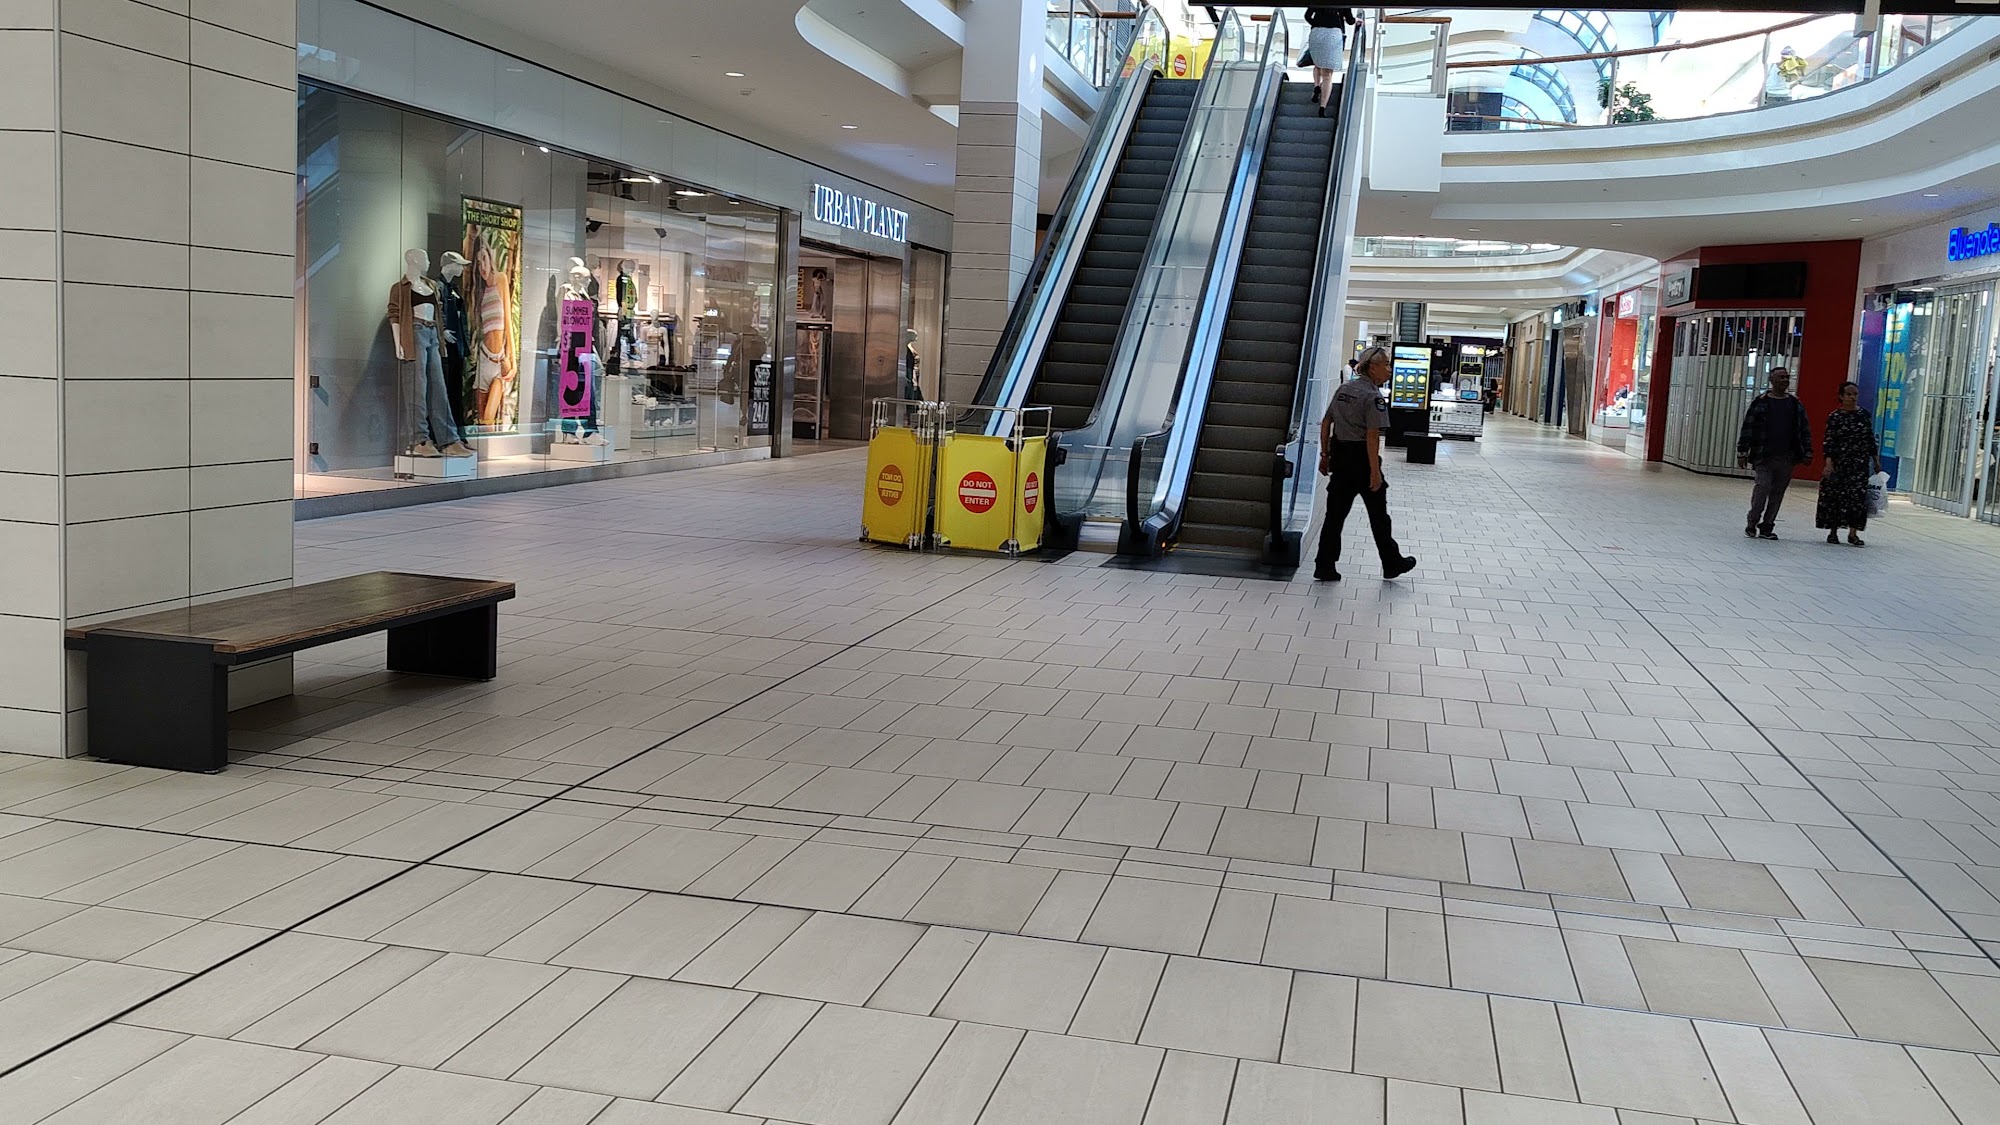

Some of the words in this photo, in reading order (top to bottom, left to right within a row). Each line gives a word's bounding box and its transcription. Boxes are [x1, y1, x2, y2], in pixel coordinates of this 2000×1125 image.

[467, 210, 480, 222] THE
[481, 213, 500, 226] SHORT
[500, 216, 517, 228] SHOP
[814, 183, 862, 231] URBAN
[863, 200, 909, 243] PLANET
[1948, 222, 2000, 261] Bluenote
[565, 305, 589, 316] SUMMER
[976, 481, 993, 489] NOT
[964, 497, 990, 505] ENTER
